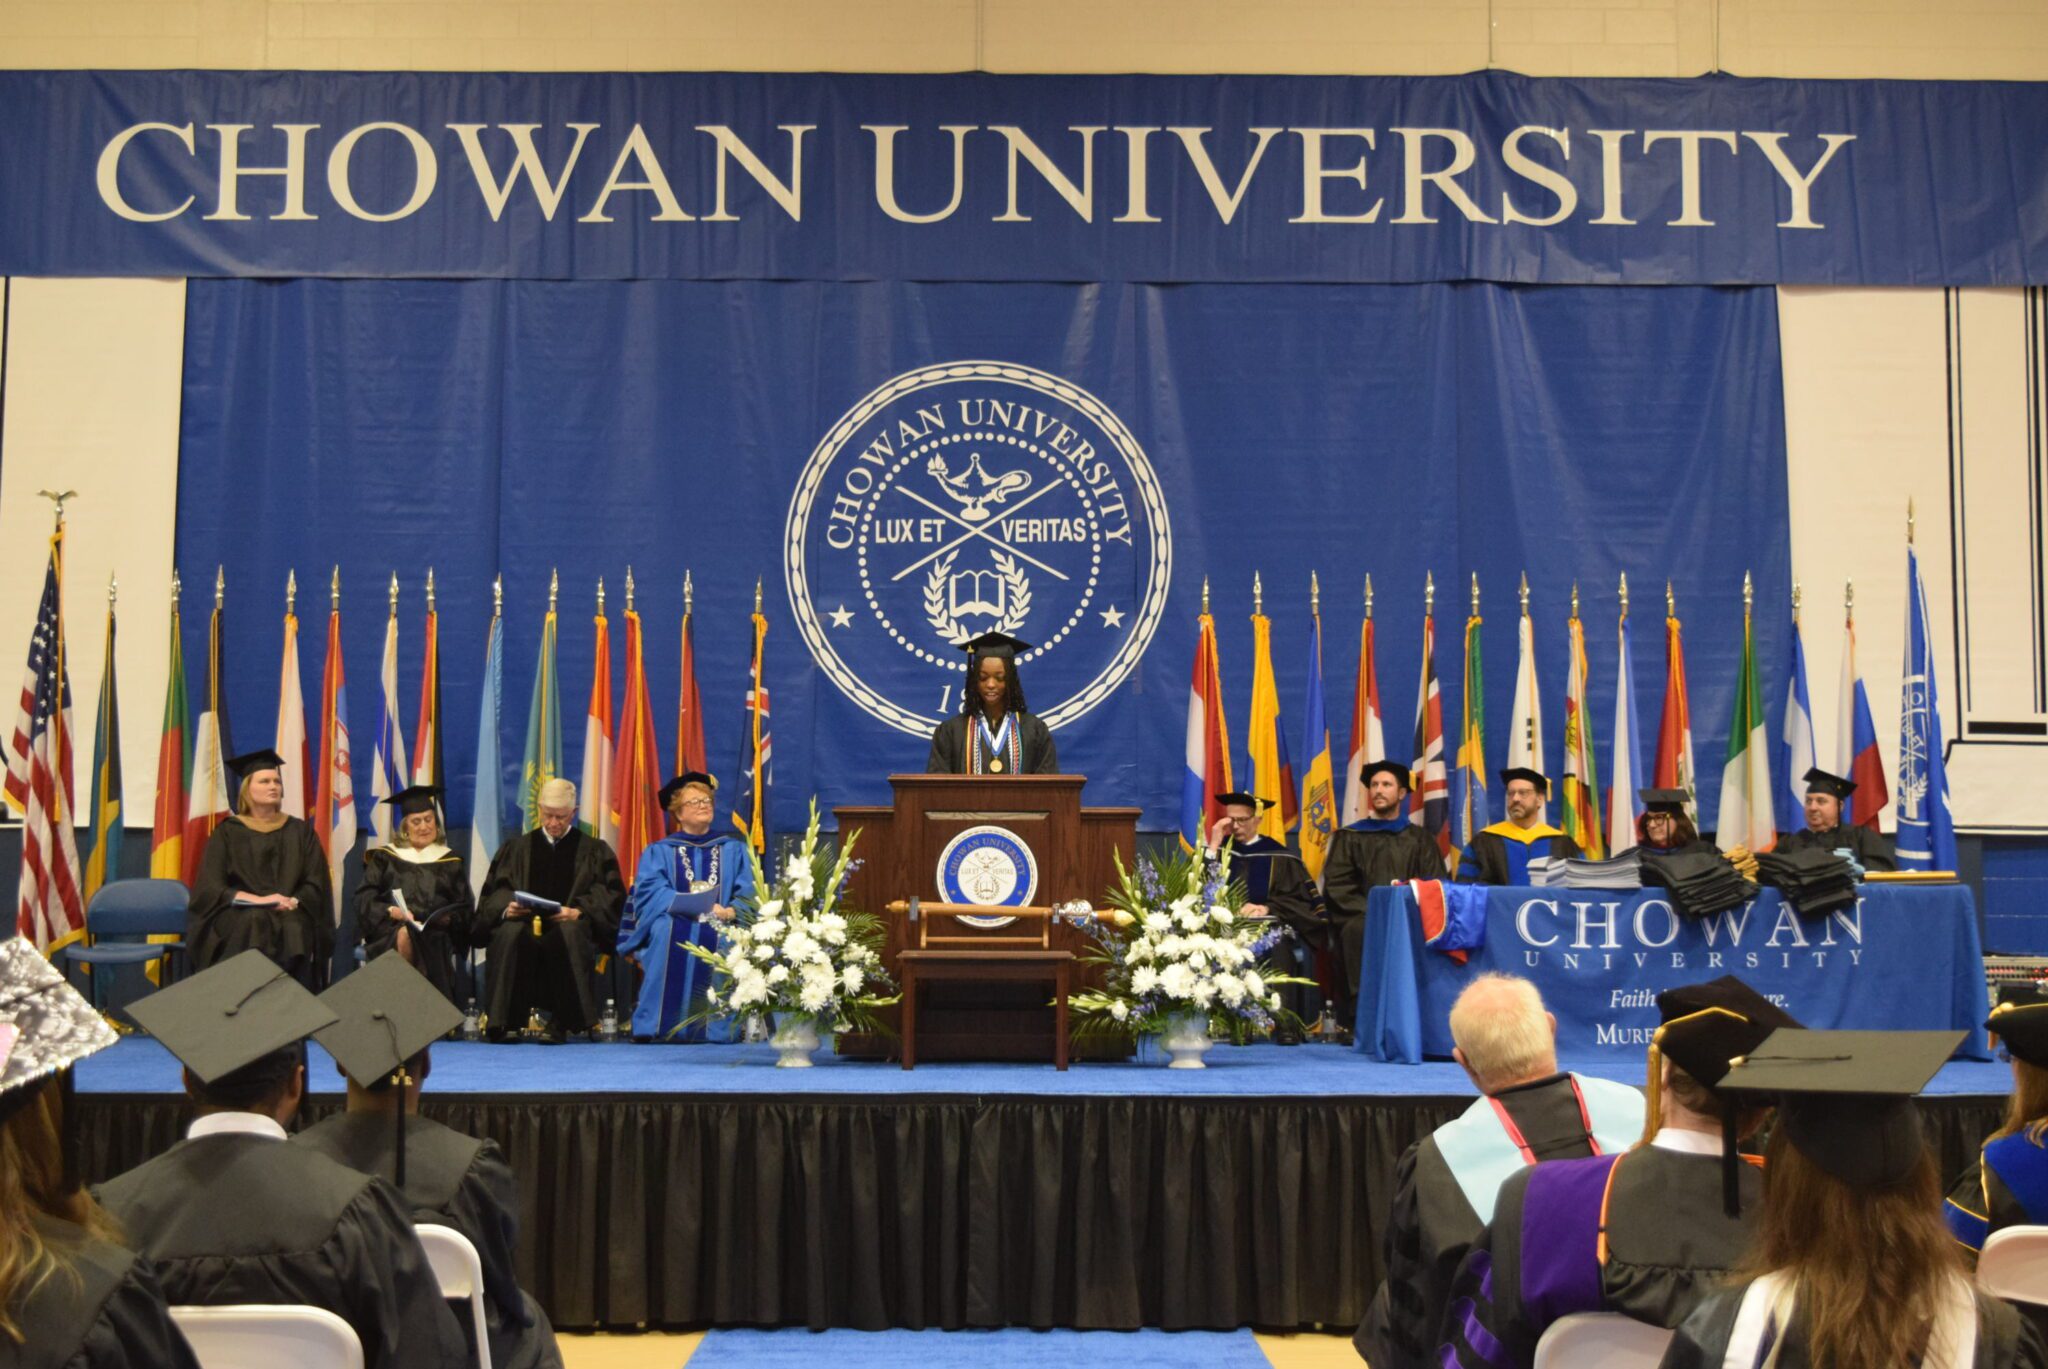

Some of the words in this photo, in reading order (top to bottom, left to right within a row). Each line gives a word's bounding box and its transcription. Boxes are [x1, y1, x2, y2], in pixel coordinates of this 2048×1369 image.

[96, 121, 818, 224] CHOWAN
[861, 124, 1857, 229] UNIVERSITY
[826, 403, 946, 549] CHOWAN
[958, 399, 1132, 547] UNIVERSITY
[875, 519, 914, 543] LUX
[920, 519, 946, 543] ET
[1000, 517, 1087, 543] VERITAS
[949, 839, 979, 876] CHOWAN
[982, 837, 1026, 876] UNIVERSITY
[1515, 896, 1866, 949] CHOWAN
[1523, 949, 1863, 969] UNIVERSITY
[1609, 988, 1656, 1008] Faith
